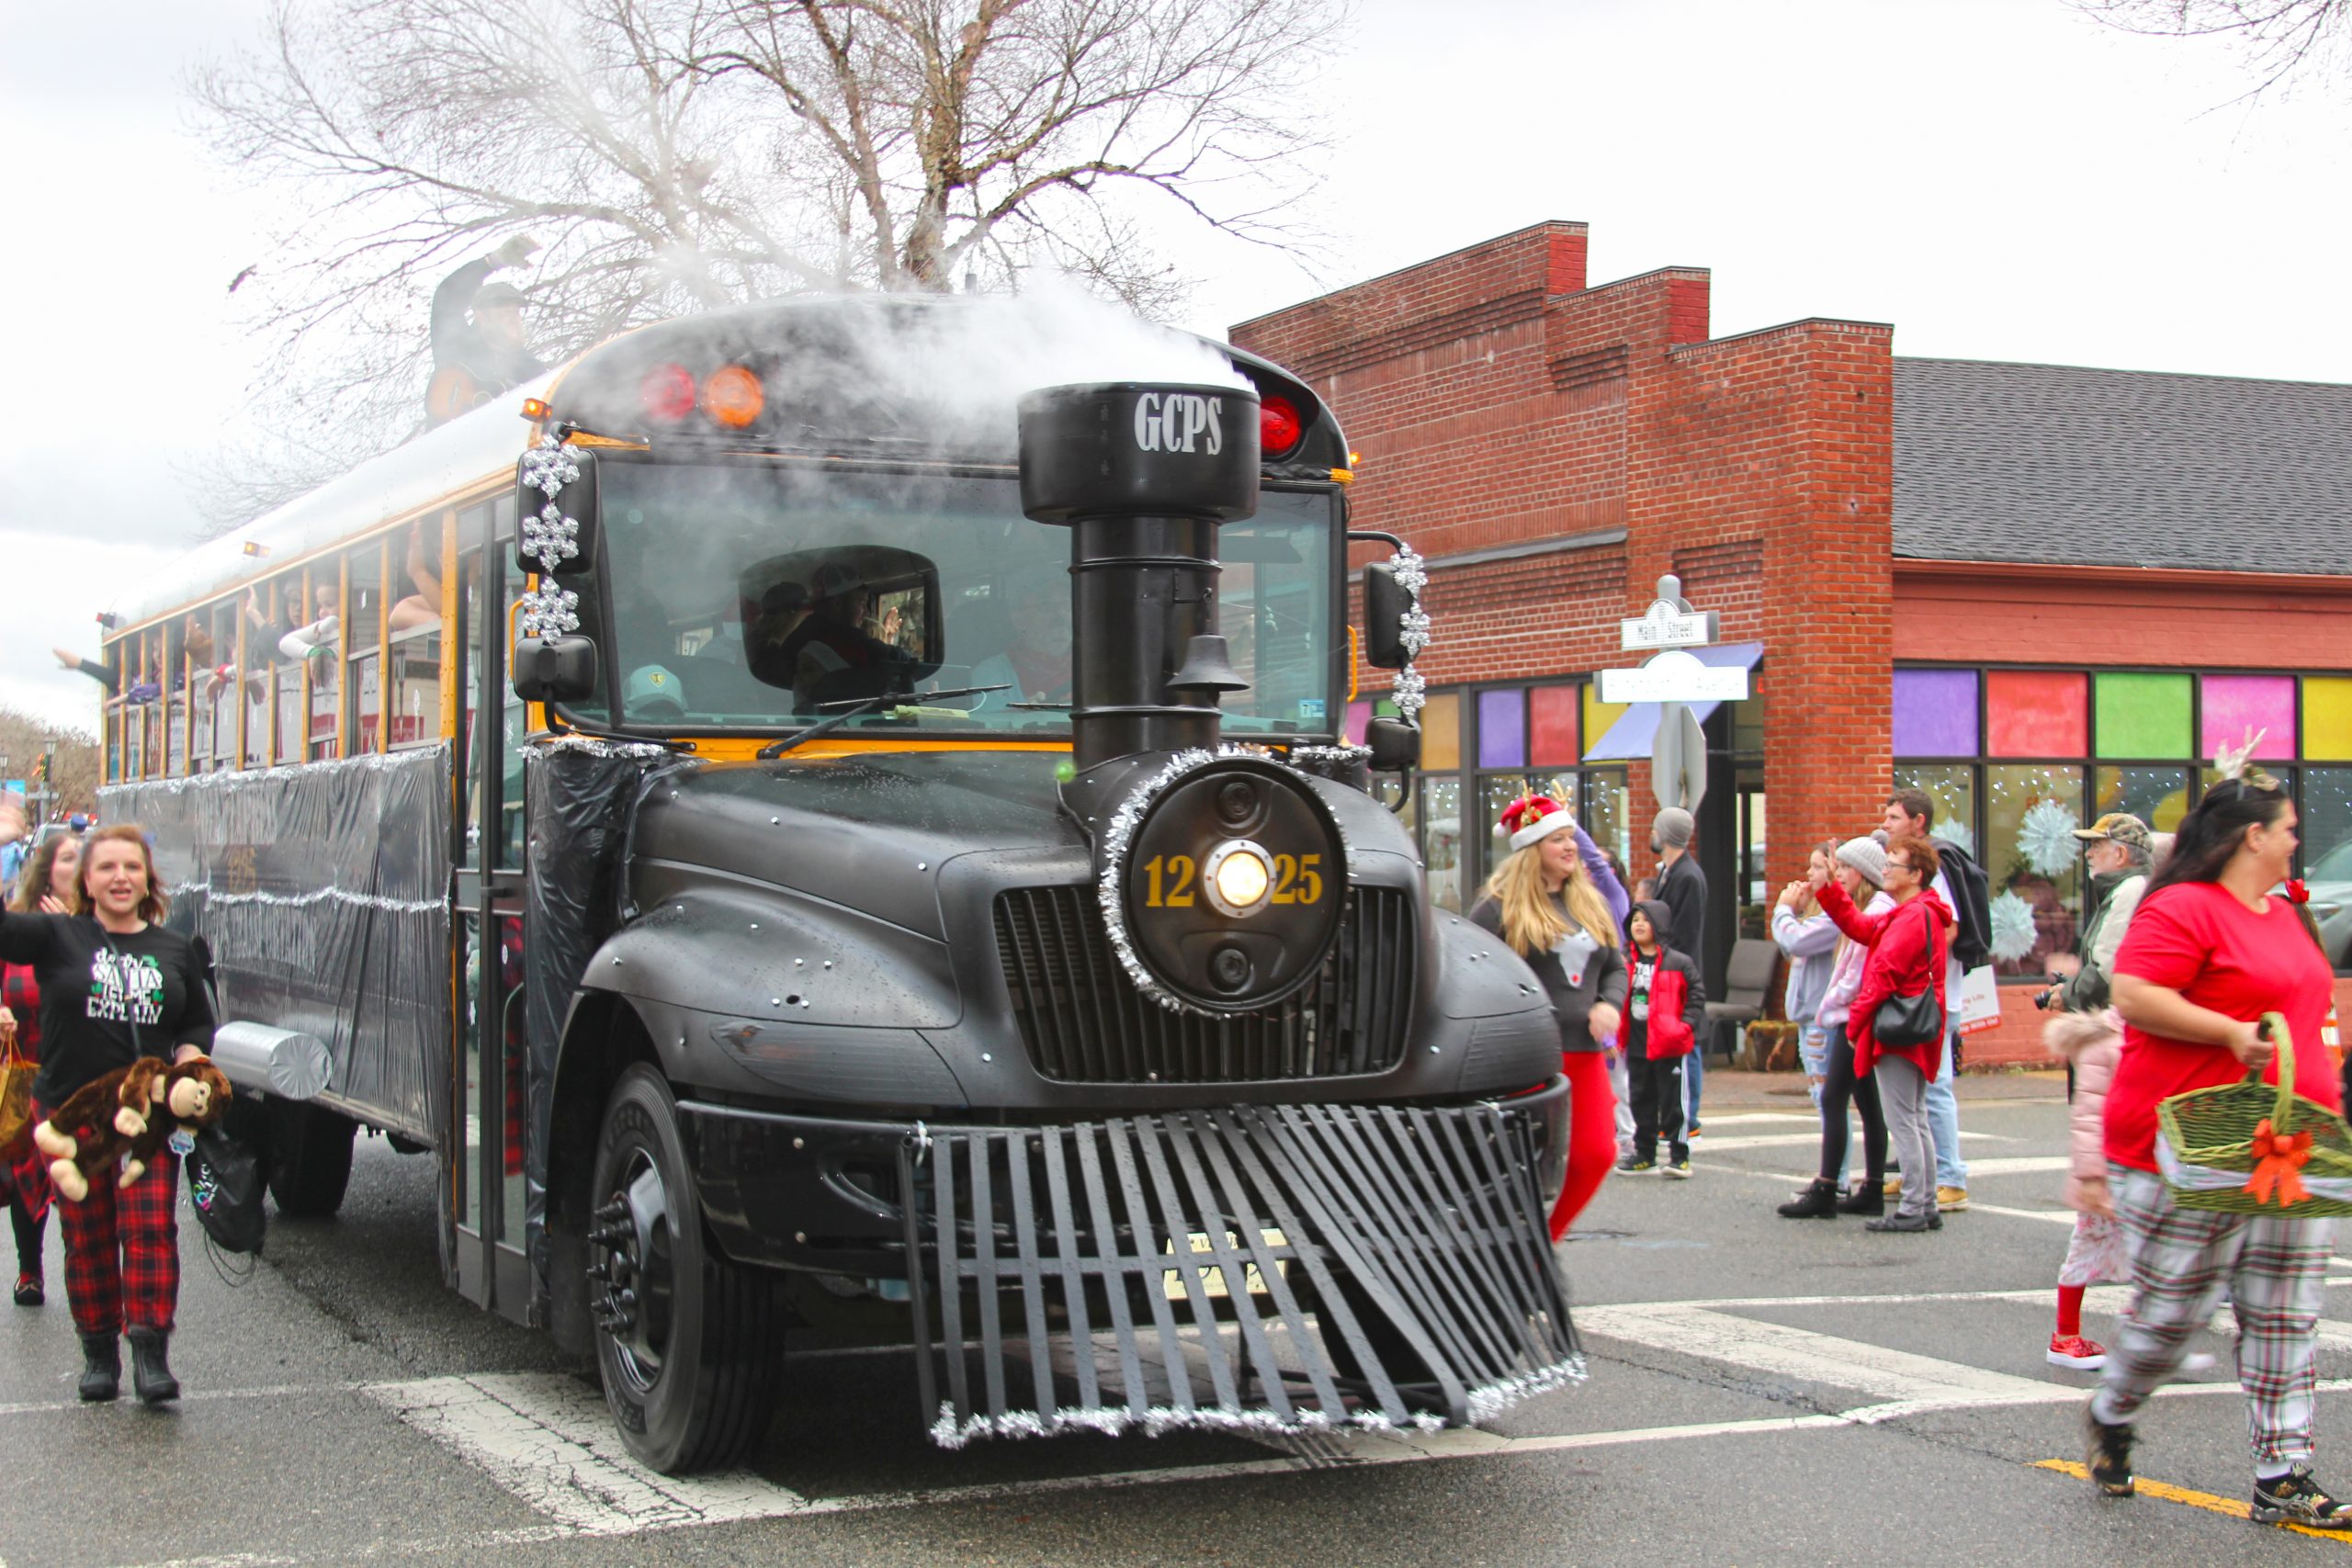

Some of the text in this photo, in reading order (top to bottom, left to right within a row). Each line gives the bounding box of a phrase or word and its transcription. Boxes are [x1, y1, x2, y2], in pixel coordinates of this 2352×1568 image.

[1135, 392, 1222, 455] GCPS
[1637, 620, 1693, 640] Main Street
[1144, 854, 1323, 907] 12 25
